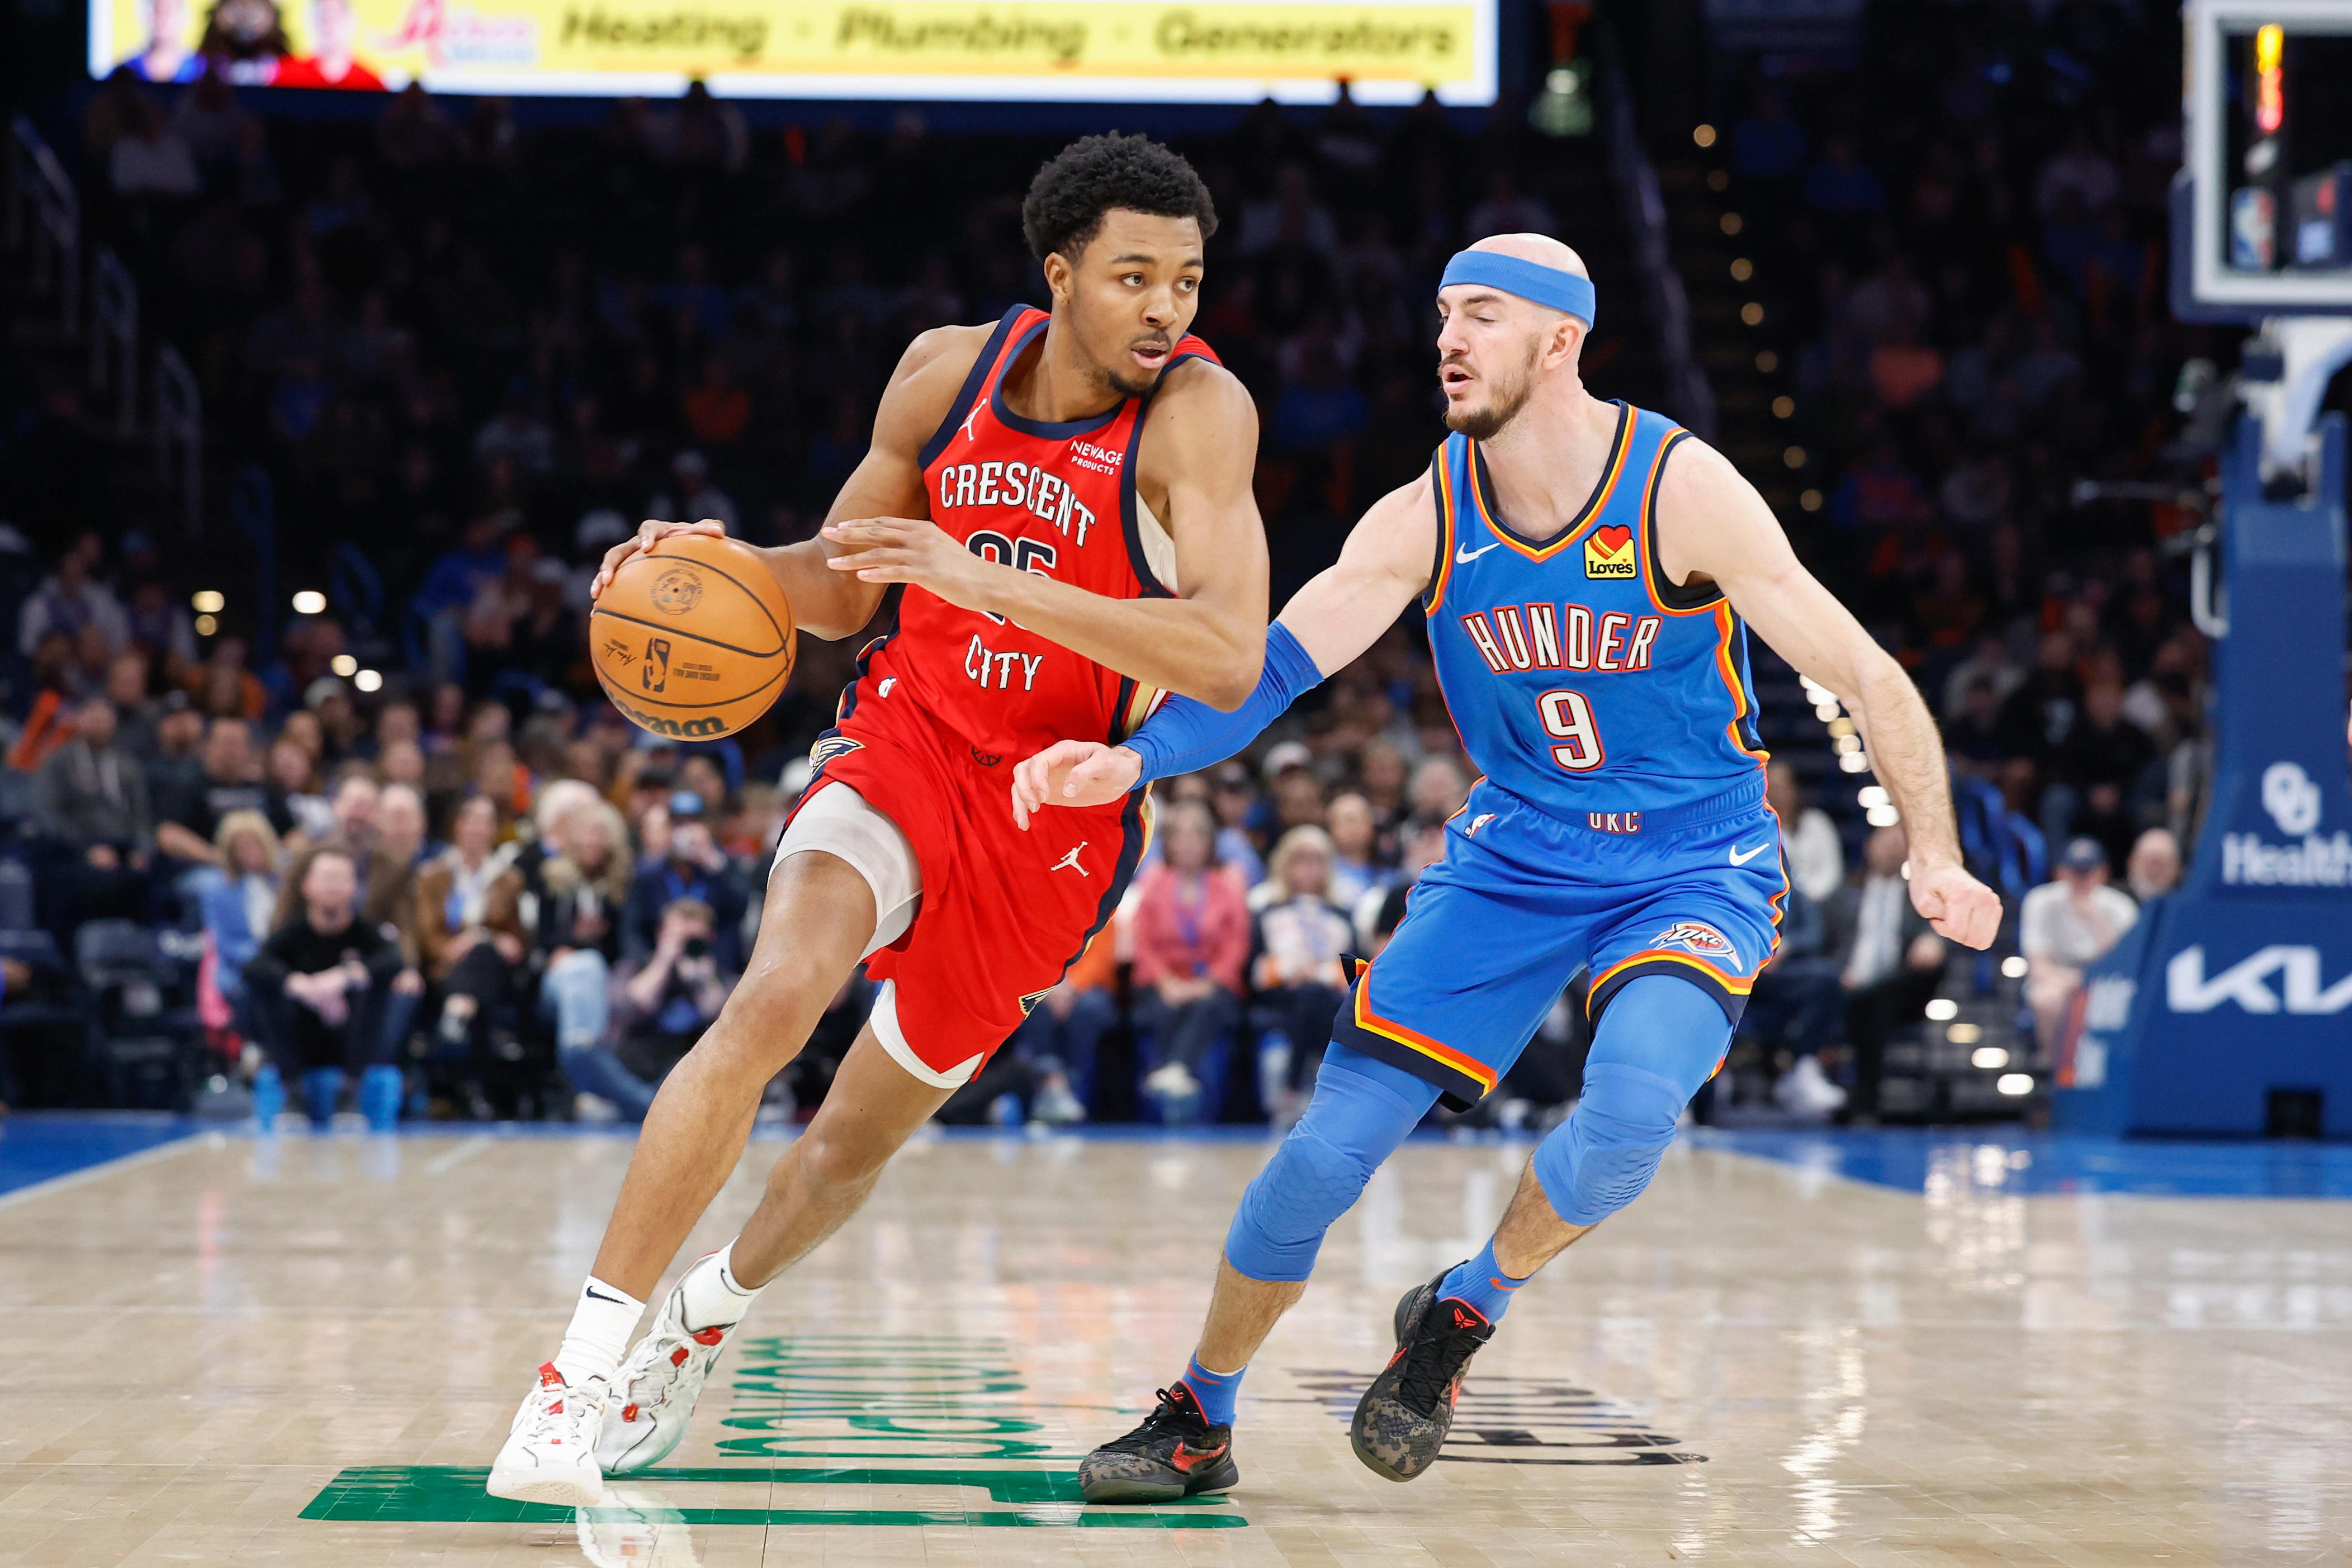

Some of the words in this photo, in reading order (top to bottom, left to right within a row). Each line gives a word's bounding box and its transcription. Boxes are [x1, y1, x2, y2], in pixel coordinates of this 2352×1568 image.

[1069, 439, 1123, 466] NEWAGE
[1071, 456, 1114, 476] PRODUCTS
[940, 461, 1096, 548] CRESCENT
[964, 633, 1044, 691] CITY
[1460, 602, 1663, 674] HUNDER
[1536, 689, 1605, 772] 9
[1663, 928, 1724, 946] OKC
